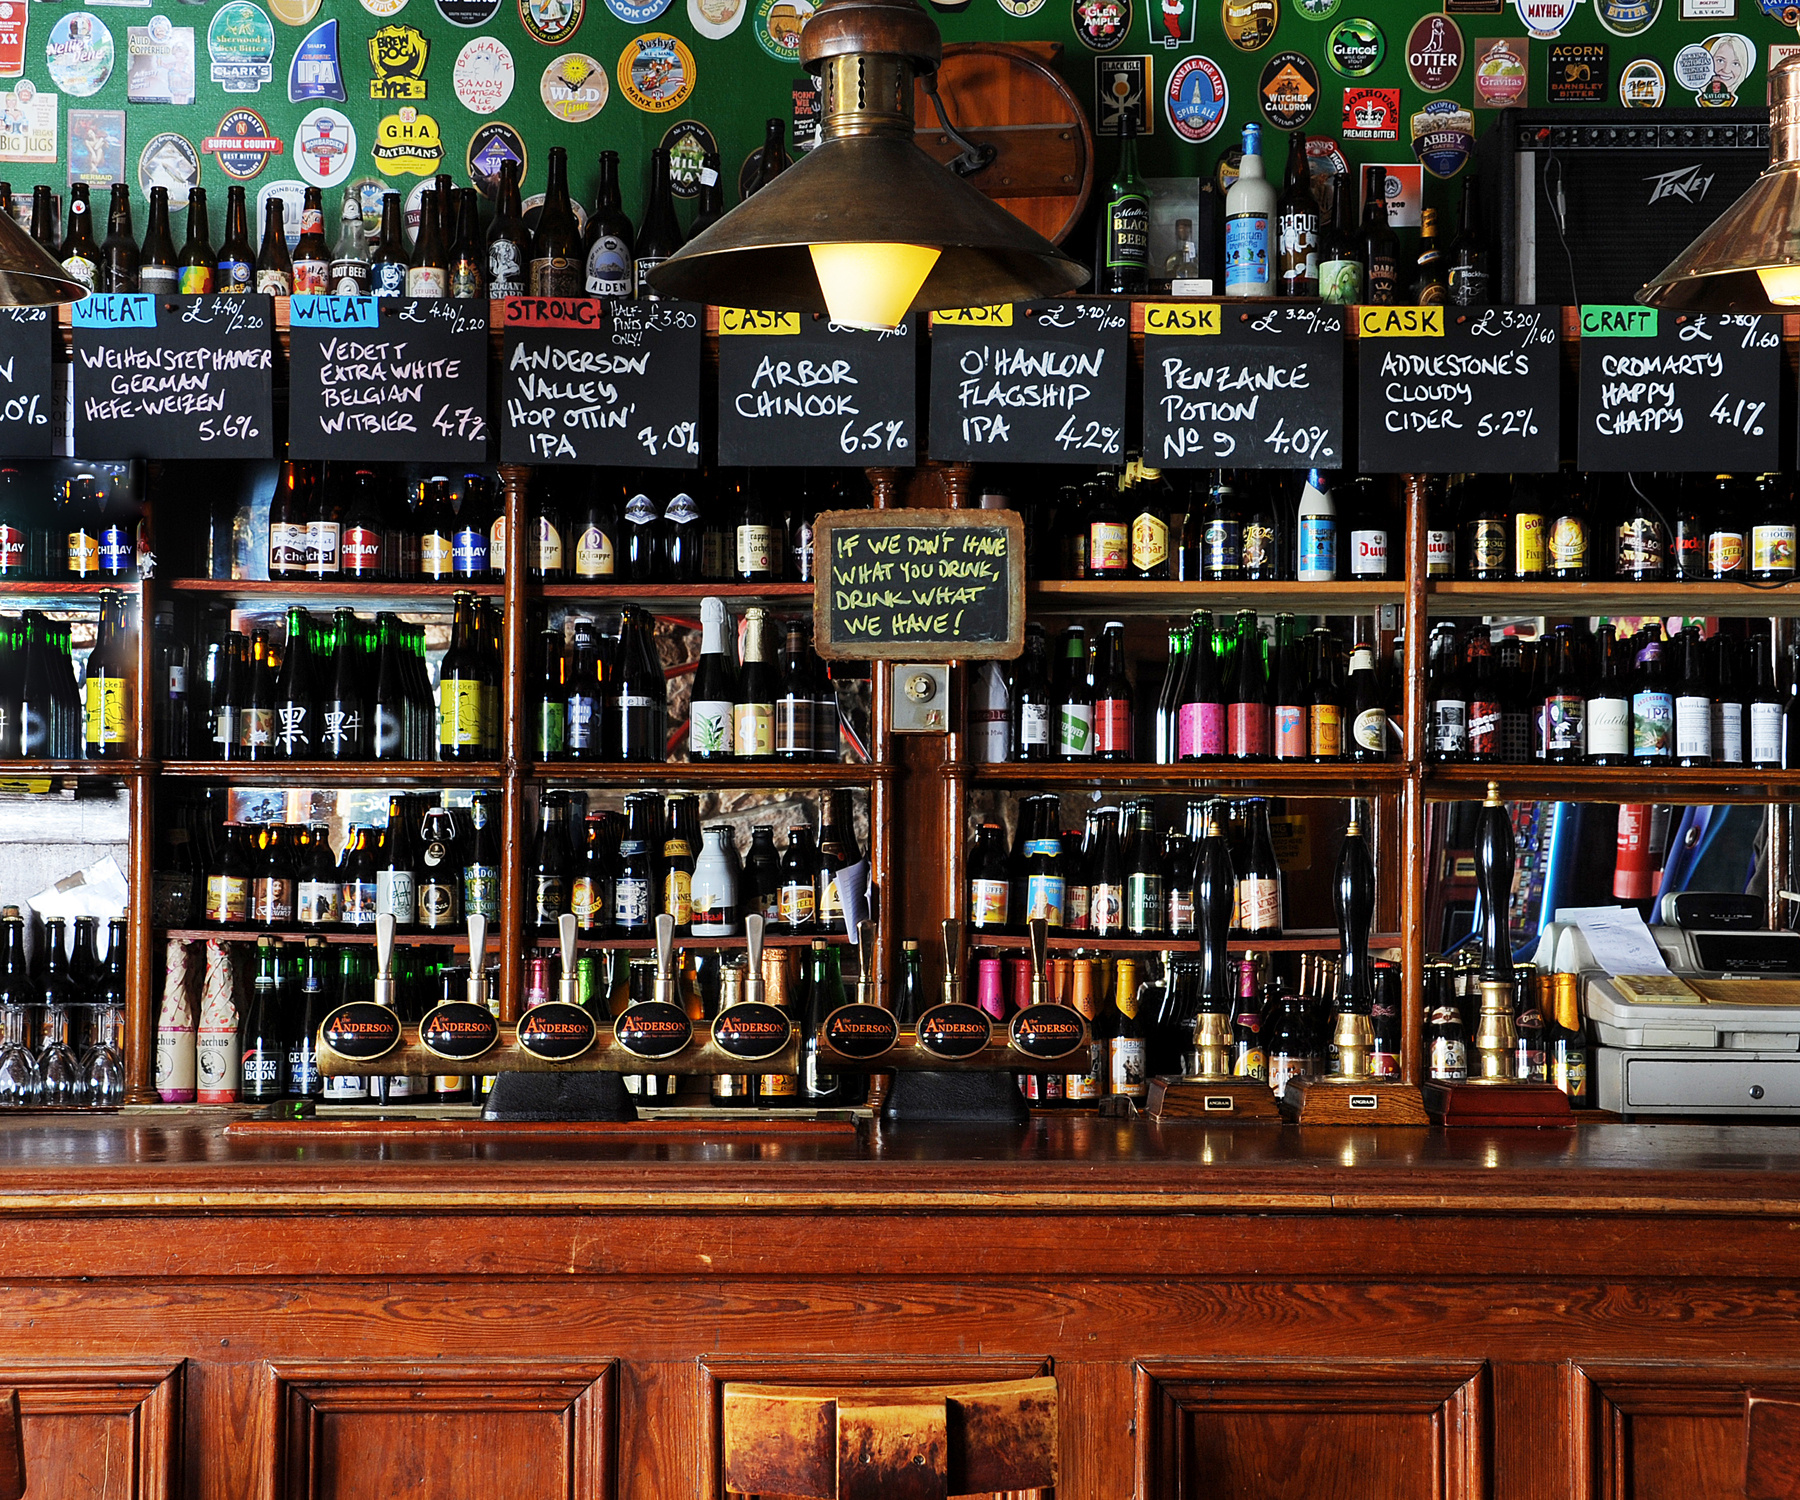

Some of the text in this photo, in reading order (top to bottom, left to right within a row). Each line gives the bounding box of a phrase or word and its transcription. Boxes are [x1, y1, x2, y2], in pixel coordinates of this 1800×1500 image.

[1088, 7, 1117, 16] GLEN
[1528, 5, 1564, 18] MAYHEM
[1607, 5, 1648, 19] BITTER
[1084, 17, 1120, 26] AMPLE
[46, 40, 84, 56] Nellie
[130, 36, 149, 44] AULD
[217, 36, 267, 44] Sherwood's
[377, 34, 409, 49] BREW
[636, 38, 677, 51] Bushy's
[72, 49, 104, 63] Dene
[129, 45, 171, 54] COPPERHEID
[379, 48, 409, 61] DOG
[458, 43, 512, 70] BELHAVEN
[1333, 45, 1378, 55] GLENCOE
[1552, 46, 1604, 56] ACORN
[1103, 61, 1140, 70] BLACK ISLE
[1410, 53, 1458, 67] OTTER
[214, 66, 269, 76] CLARK'S
[298, 61, 336, 83] IPA
[1171, 60, 1224, 96] STONEHENGE ALES
[1426, 67, 1442, 75] ALE
[373, 80, 412, 98] HYPE
[457, 79, 502, 88] SANDY
[1480, 76, 1522, 88] Gravitas
[459, 89, 502, 97] HUNTERS
[469, 96, 492, 105] ALE
[550, 87, 599, 101] WILD
[627, 86, 689, 109] MANX BITTER
[792, 91, 815, 100] HORNY
[1269, 93, 1308, 102] WITCHES
[554, 99, 589, 116] Time
[794, 106, 813, 115] DEVIL
[1176, 105, 1216, 119] SPIRE ALE
[1265, 103, 1312, 111] CAULDRON
[1342, 89, 1398, 123] MOORHOUSES
[222, 114, 262, 132] NETHERGATE
[387, 126, 434, 138] G.H.A.
[1343, 129, 1395, 139] PREMIER BITTER
[1, 136, 53, 154] BIG JUGS
[208, 139, 276, 149] SUFFOLK COUNTY
[305, 138, 343, 149] BOMBARDIER
[1423, 134, 1465, 147] ABBEY
[379, 146, 438, 158] BATEMANS
[1642, 164, 1716, 206] PEAVEY
[1115, 219, 1149, 231] BLACK
[1279, 214, 1319, 233] ROGUE
[1118, 233, 1147, 246] BEER
[349, 267, 366, 278] BEER
[221, 284, 245, 293] SPACE
[591, 282, 627, 293] ALDEN
[75, 297, 149, 322] WHEAT
[293, 298, 372, 322] WHEAT
[507, 300, 596, 324] STRONG
[613, 318, 642, 331] PINTS
[723, 309, 792, 330] CASK
[1147, 309, 1213, 328] CASK
[1363, 310, 1439, 333] CASK
[1583, 312, 1650, 332] CRAFT
[612, 332, 642, 347] ONLY!
[509, 342, 650, 375] ANDERSON
[960, 345, 1105, 377] O'HANLON
[1381, 350, 1529, 377] ADDLESTONE'S
[1602, 352, 1723, 377] CROMARTY
[320, 358, 461, 385] EXTRA WHITE
[752, 355, 858, 389] ARBOR
[1162, 358, 1310, 391] PENZANCE
[111, 372, 210, 394] GERMAN
[518, 373, 618, 404] VALLEY
[321, 384, 423, 407] BELGIAN
[958, 378, 1091, 410] FLAGSHIP
[1385, 383, 1472, 405] CLOUDY
[1601, 382, 1675, 409] HAPPY
[85, 389, 225, 421] HEFE-WEIZEN
[735, 391, 859, 418] CHINOOK
[1160, 395, 1259, 422] POTION
[507, 398, 636, 429] HOP OTTIN'
[1596, 393, 1766, 436] CHAPPY 4.1%
[199, 415, 259, 441] 5.6%
[320, 404, 486, 441] WITBIER 4.7%
[1385, 408, 1539, 437] CIDER 5.2%
[529, 422, 699, 459] IPA 7.0%
[841, 420, 908, 453] 6.5%
[962, 414, 1121, 453] IPA 4.2%
[1213, 431, 1236, 457] 9
[1264, 417, 1334, 460] 4.0%
[837, 532, 1006, 558] IF WE DON'T HAVE
[834, 559, 999, 586] WHAT YOU DRINK,
[836, 586, 986, 611] DRINK WHAT
[844, 615, 882, 636] WE
[1646, 708, 1670, 720] IPA
[331, 1017, 394, 1033] ANDERSON
[428, 1016, 492, 1033] ANDERSON
[525, 1017, 588, 1033] ANDERSON
[622, 1016, 686, 1032] ANDERSON
[720, 1017, 783, 1032] ANDERSON
[831, 1018, 892, 1034] ANDERSON
[925, 1017, 986, 1033] ANDERSON
[1019, 1018, 1079, 1034] ANDERSON
[244, 1060, 277, 1071] GEUZE
[245, 1070, 276, 1081] BOON
